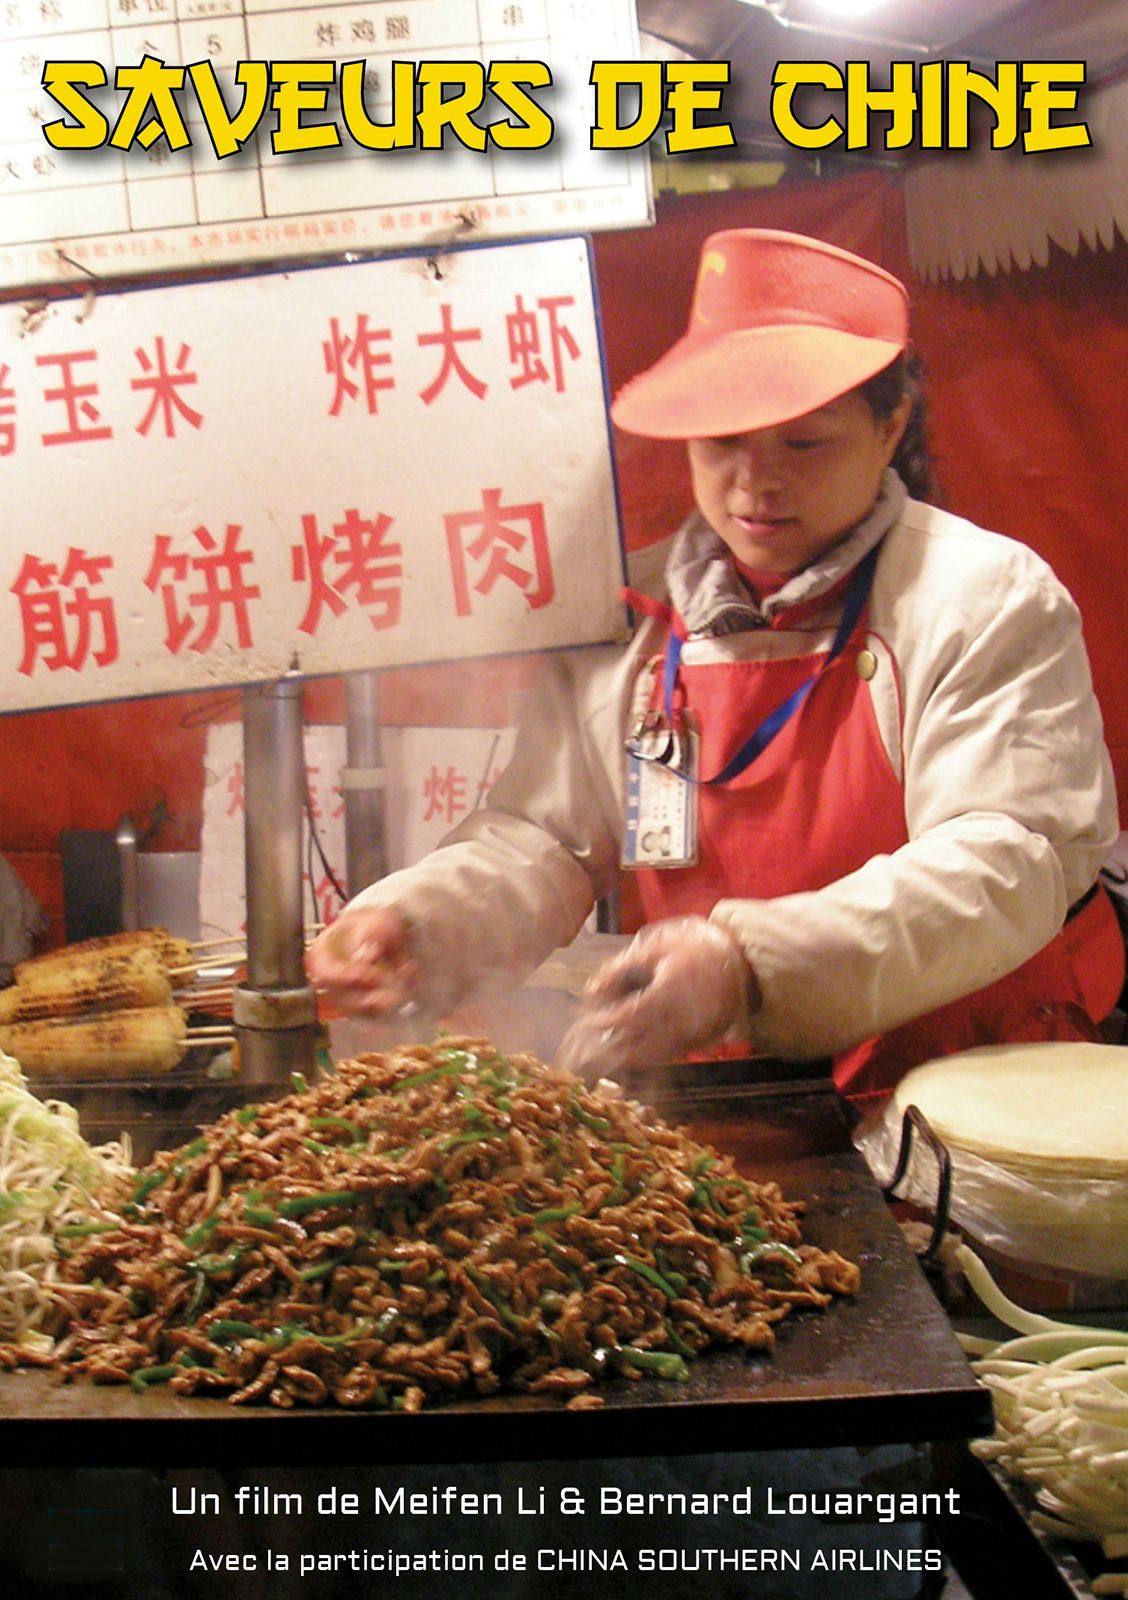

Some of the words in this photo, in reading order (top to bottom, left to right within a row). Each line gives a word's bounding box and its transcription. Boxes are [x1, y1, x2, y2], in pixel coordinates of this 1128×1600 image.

[206, 34, 222, 55] 5
[322, 295, 582, 417] 炸大虾
[10, 488, 557, 677] 筋饼烤肉
